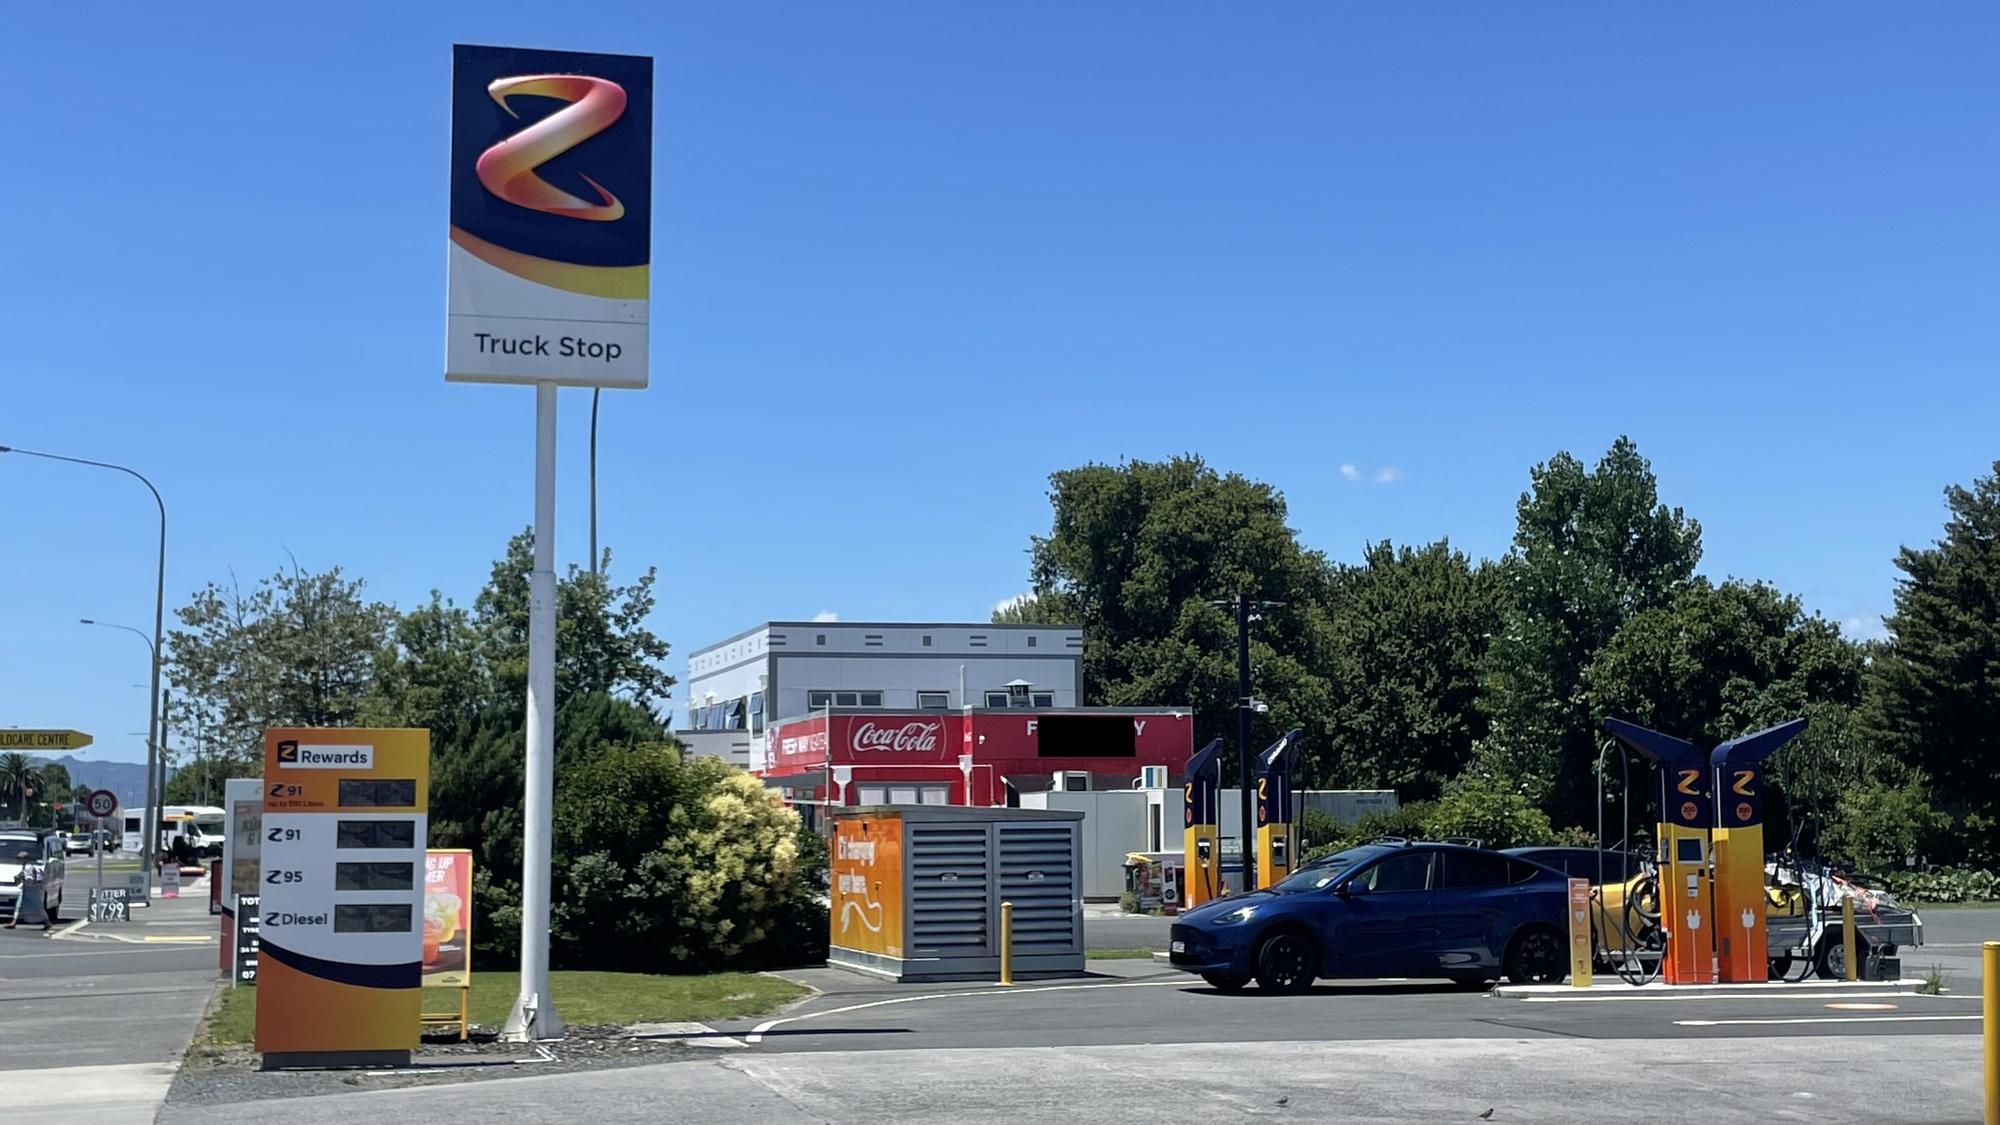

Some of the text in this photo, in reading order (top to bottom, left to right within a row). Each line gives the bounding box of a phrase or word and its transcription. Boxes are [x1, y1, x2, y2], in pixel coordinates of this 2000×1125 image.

[474, 333, 622, 363] Truck Stop
[37, 733, 70, 746] CENTRE
[853, 722, 941, 752] Coca-Cola
[301, 750, 368, 764] Rewards
[287, 785, 302, 796] 91
[95, 798, 110, 809] 50
[286, 829, 300, 841] 91
[284, 871, 303, 883] 95
[282, 913, 328, 925] Diesel
